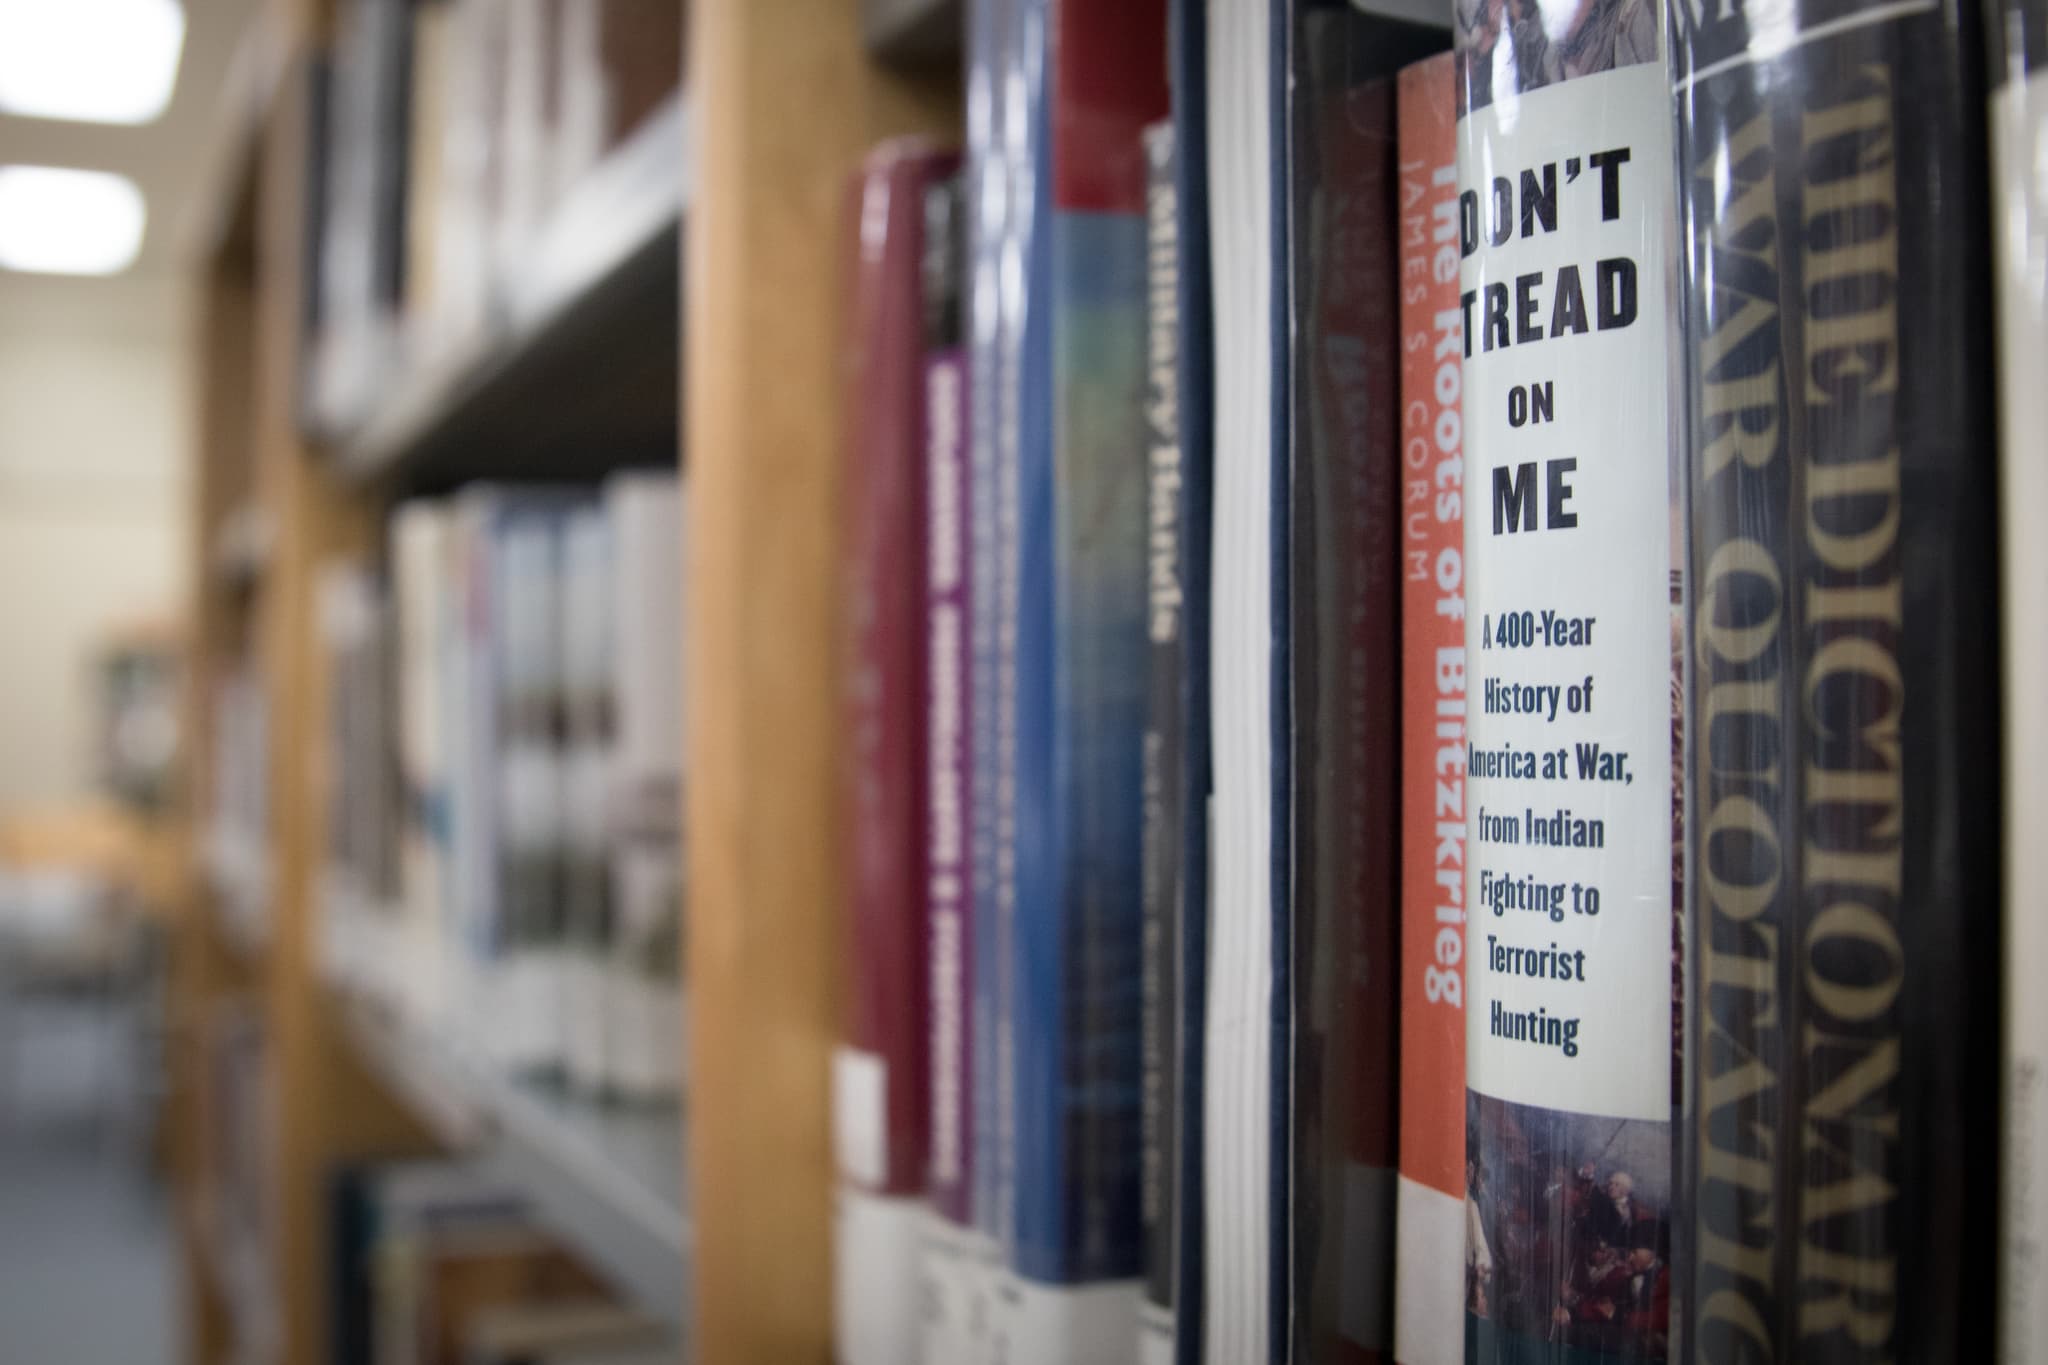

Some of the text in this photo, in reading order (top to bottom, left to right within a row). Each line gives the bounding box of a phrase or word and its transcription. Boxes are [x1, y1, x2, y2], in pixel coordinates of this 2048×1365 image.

[1459, 146, 1631, 260] DON’T
[1460, 256, 1638, 360] TREAD
[1697, 108, 1779, 481] WAR
[1402, 160, 1429, 581] JAMES S. CORUM
[1508, 380, 1555, 428] ON
[1492, 458, 1580, 536] ME
[1424, 164, 1465, 1009] The Roots of Blitzkrieg
[1482, 609, 1596, 650] A 400-Year
[1484, 675, 1593, 722] History of
[1801, 62, 1903, 1352] THE DICTIONAR
[1468, 741, 1633, 786] America at War,
[1479, 796, 1604, 849] from Indian
[1480, 870, 1600, 923] Fighting to
[1487, 934, 1586, 982] Terrorist
[1490, 999, 1580, 1058] Hunting
